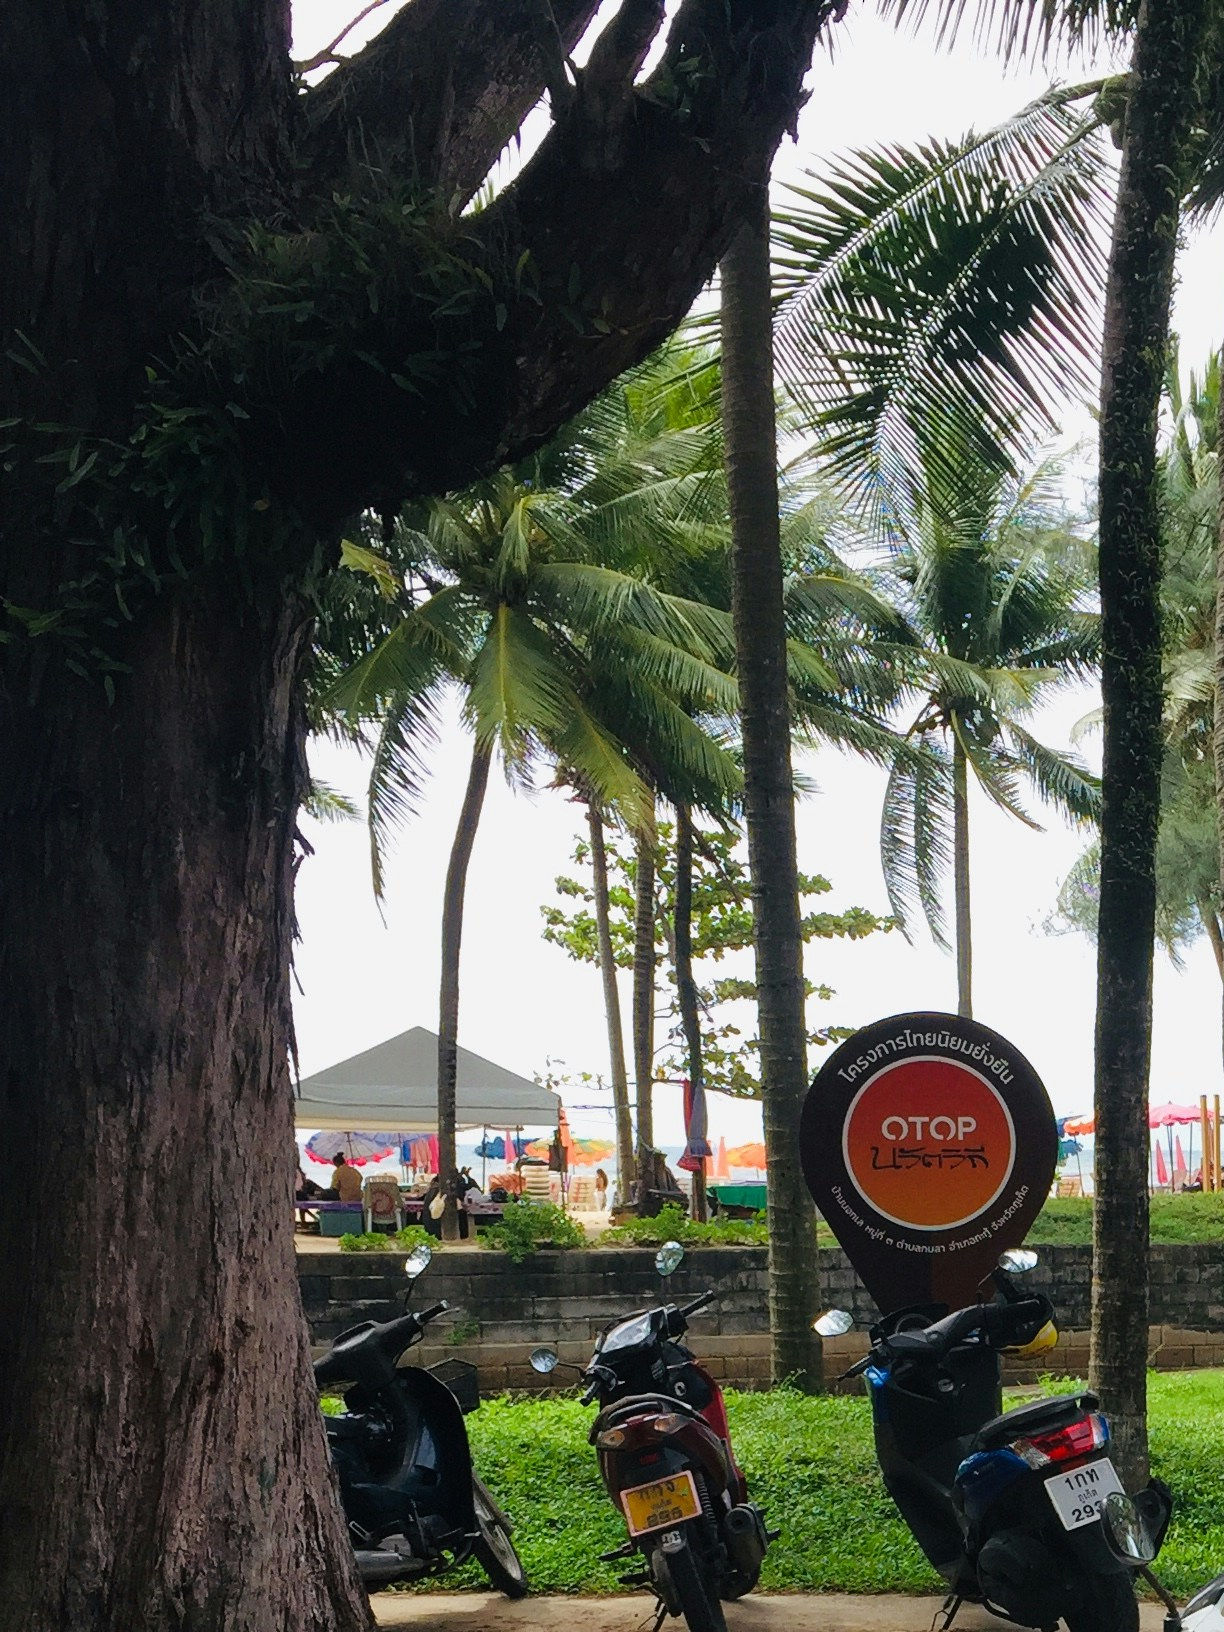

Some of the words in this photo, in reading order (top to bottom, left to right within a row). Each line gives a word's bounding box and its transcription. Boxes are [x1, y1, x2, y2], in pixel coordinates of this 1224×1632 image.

[837, 1029, 1015, 1085] โครงการไทยนิยมยั่งยืน
[881, 1115, 977, 1141] OTOP
[896, 1238, 946, 1254] ตำบลกมลา
[948, 1227, 993, 1252] อำเภอกะทู้
[990, 1184, 1030, 1231] จังหวัดภูเก็ต
[1065, 1468, 1100, 1491] 1กท
[1077, 1488, 1099, 1504] ภูเก็ต
